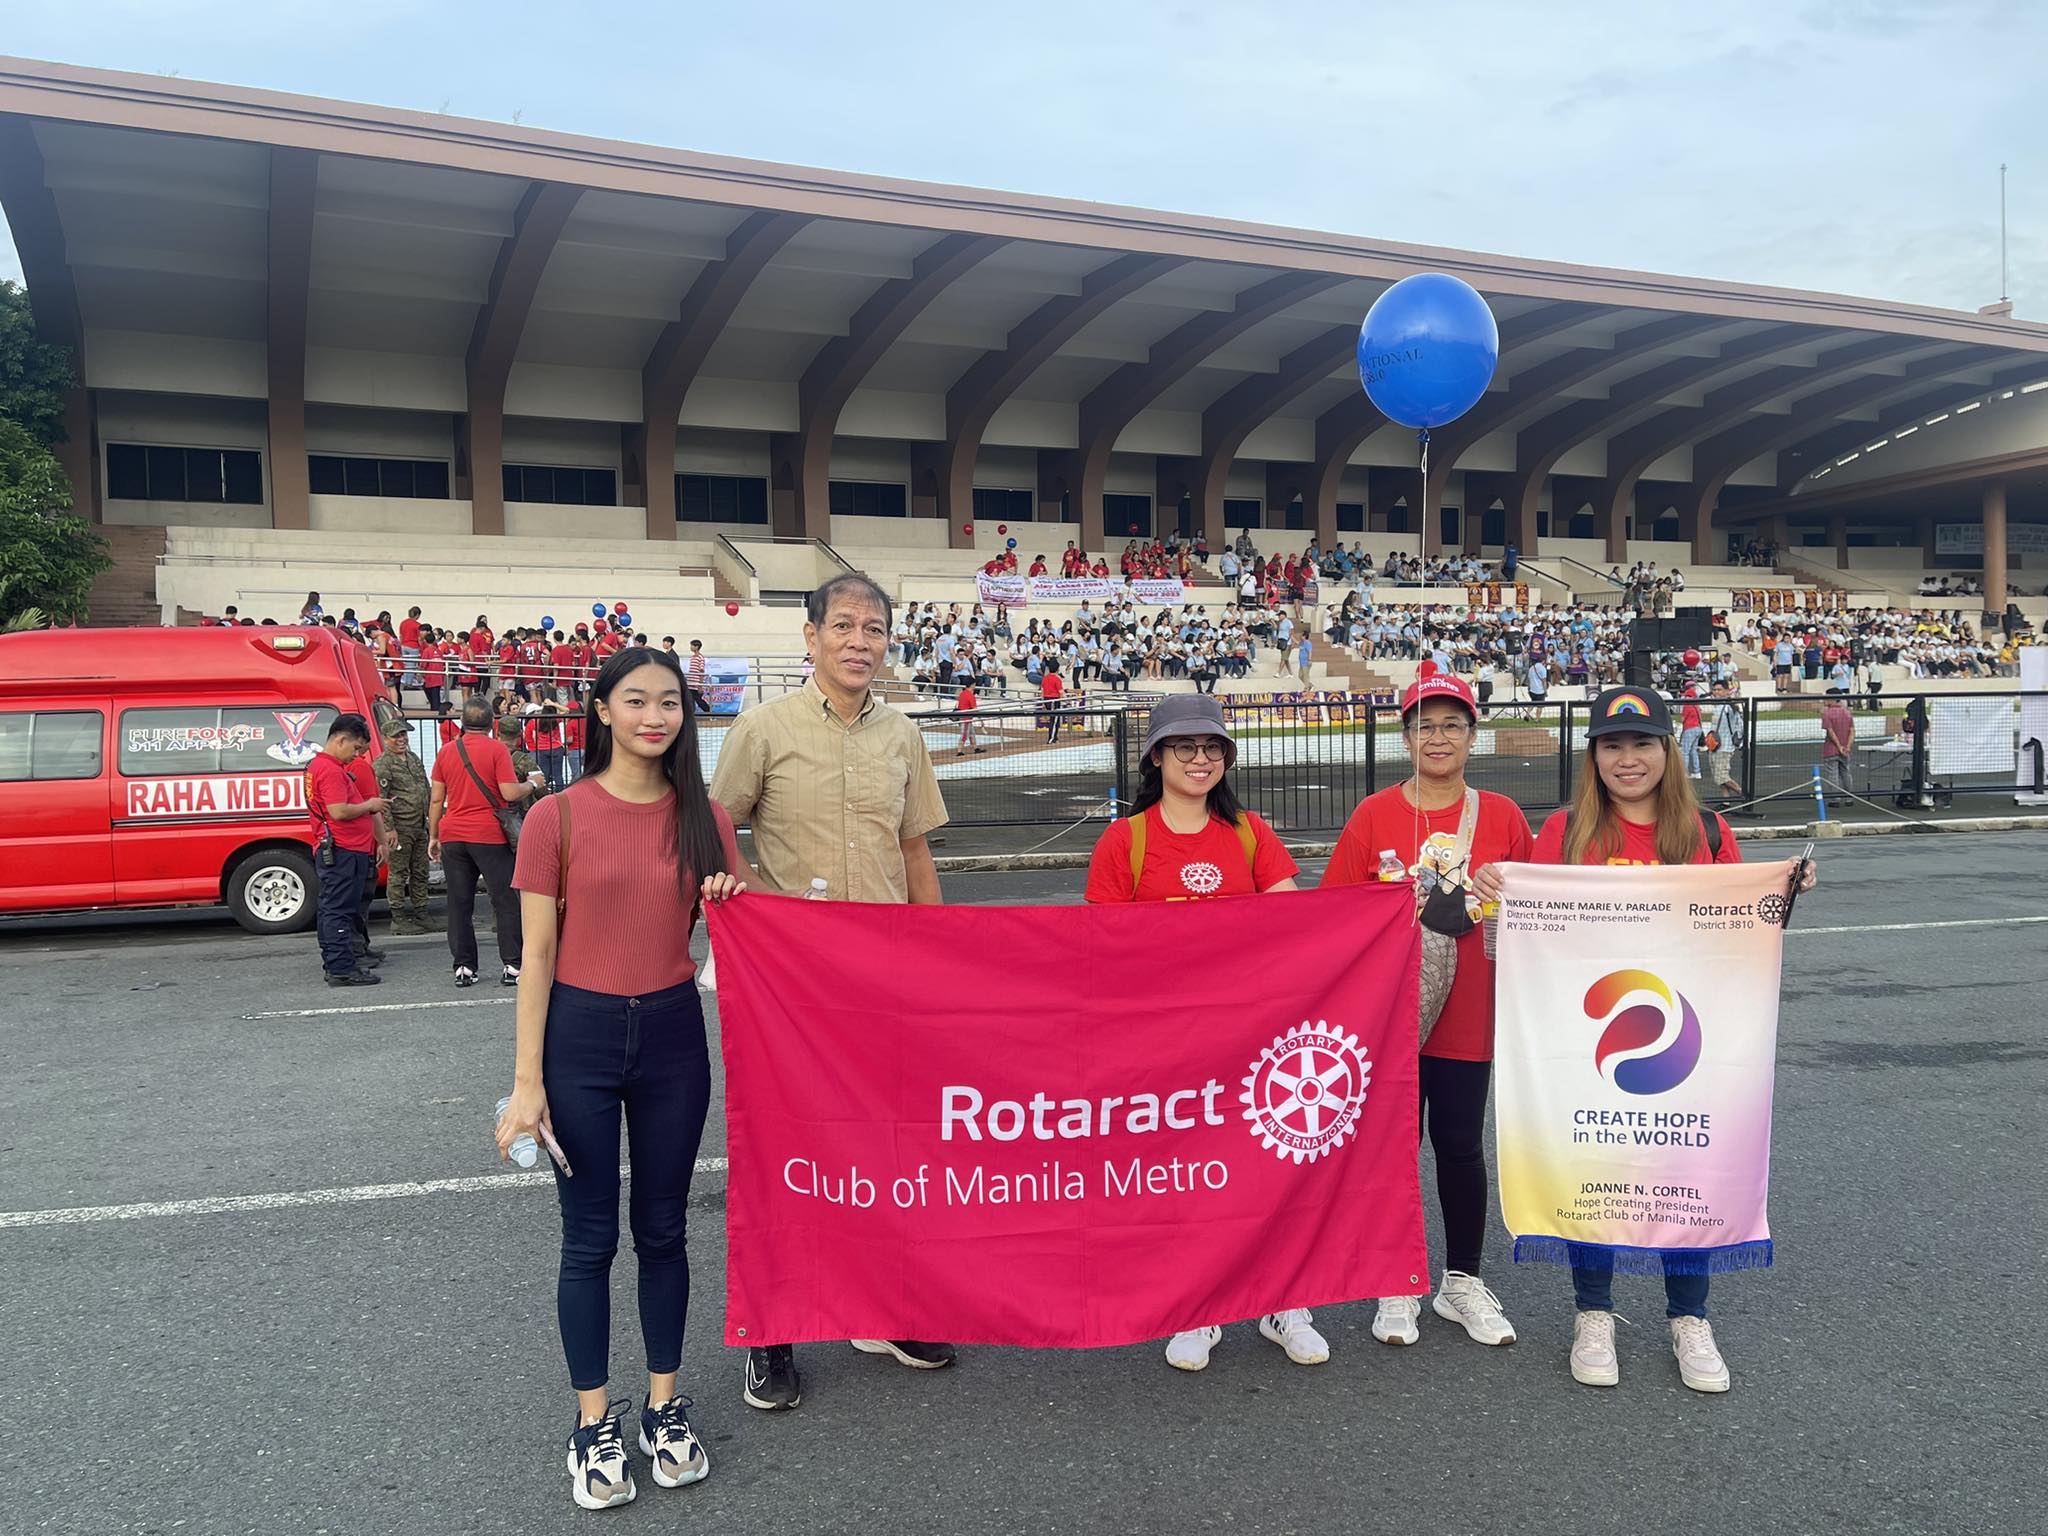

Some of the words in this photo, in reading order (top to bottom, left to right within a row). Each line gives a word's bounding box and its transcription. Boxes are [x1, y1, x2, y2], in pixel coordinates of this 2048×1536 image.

[131, 781, 216, 814] RAHA
[1546, 901, 1574, 911] ANNE
[1578, 902, 1612, 912] MARIE
[1614, 903, 1624, 912] V.
[1626, 902, 1672, 913] PARLADE
[1689, 903, 1753, 917] Rotaract
[1537, 912, 1577, 923] Rotaract
[1579, 912, 1650, 925] Representative
[1693, 920, 1726, 930] District
[1729, 919, 1753, 930] 3810
[1279, 1035, 1336, 1056] ROTARY
[941, 1078, 1225, 1142] Rotaract
[1574, 1110, 1647, 1127] CREATE
[1654, 1113, 1710, 1129] HOPE
[1264, 1106, 1355, 1149] INTERNATIONAL
[1573, 1128, 1589, 1143] in
[1596, 1129, 1627, 1144] the
[1633, 1130, 1710, 1147] WORLD
[783, 1158, 875, 1208] Club
[893, 1164, 929, 1208] of
[945, 1161, 1085, 1206] Manila
[1105, 1157, 1229, 1197] Metro
[1581, 1183, 1630, 1194] JOANNE
[1634, 1185, 1648, 1195] N.
[1652, 1186, 1702, 1200] CORTEL
[1574, 1198, 1600, 1209] Hope
[1603, 1197, 1651, 1212] Creating
[1655, 1200, 1709, 1214] President
[1556, 1208, 1601, 1221] Rotaract
[1603, 1209, 1629, 1220] Club
[1632, 1211, 1645, 1222] of
[1647, 1213, 1686, 1225] Manila
[1690, 1216, 1724, 1227] Metro
